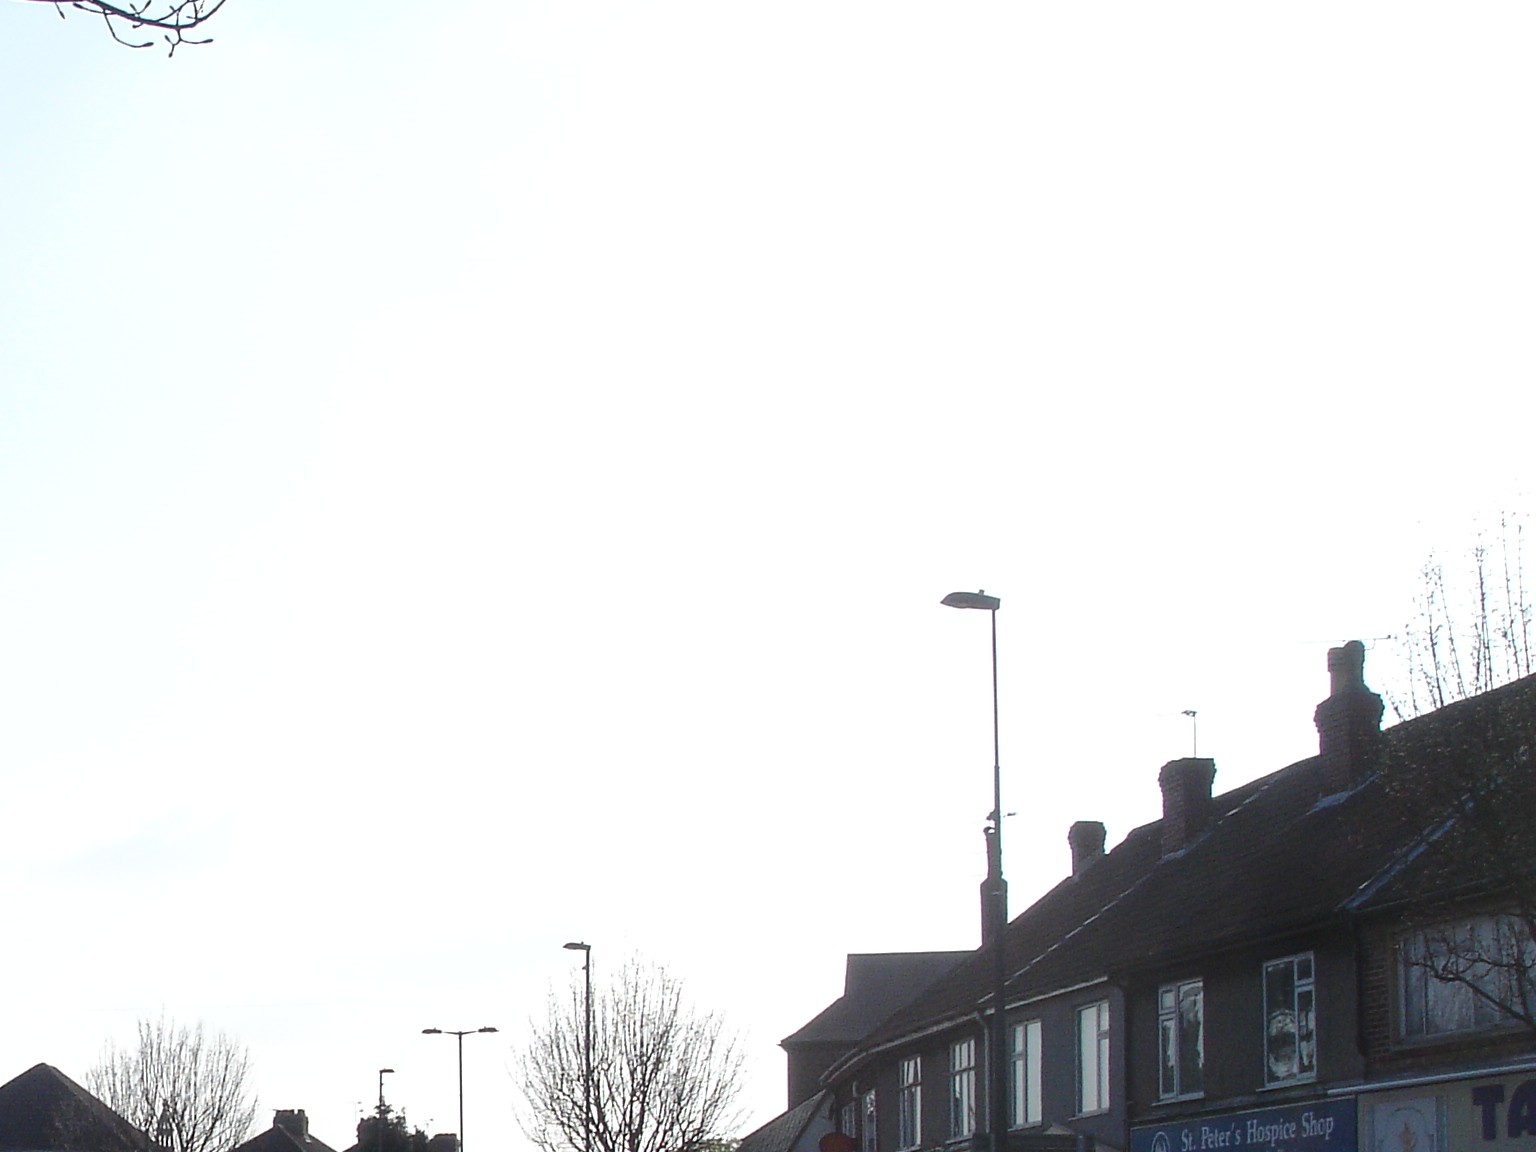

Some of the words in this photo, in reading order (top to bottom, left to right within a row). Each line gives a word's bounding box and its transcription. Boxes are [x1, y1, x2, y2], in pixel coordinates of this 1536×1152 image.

[1181, 1129, 1197, 1152] St.
[1201, 1122, 1241, 1151] Peter's
[1246, 1117, 1297, 1147] Hospice
[1301, 1112, 1335, 1141] Shop
